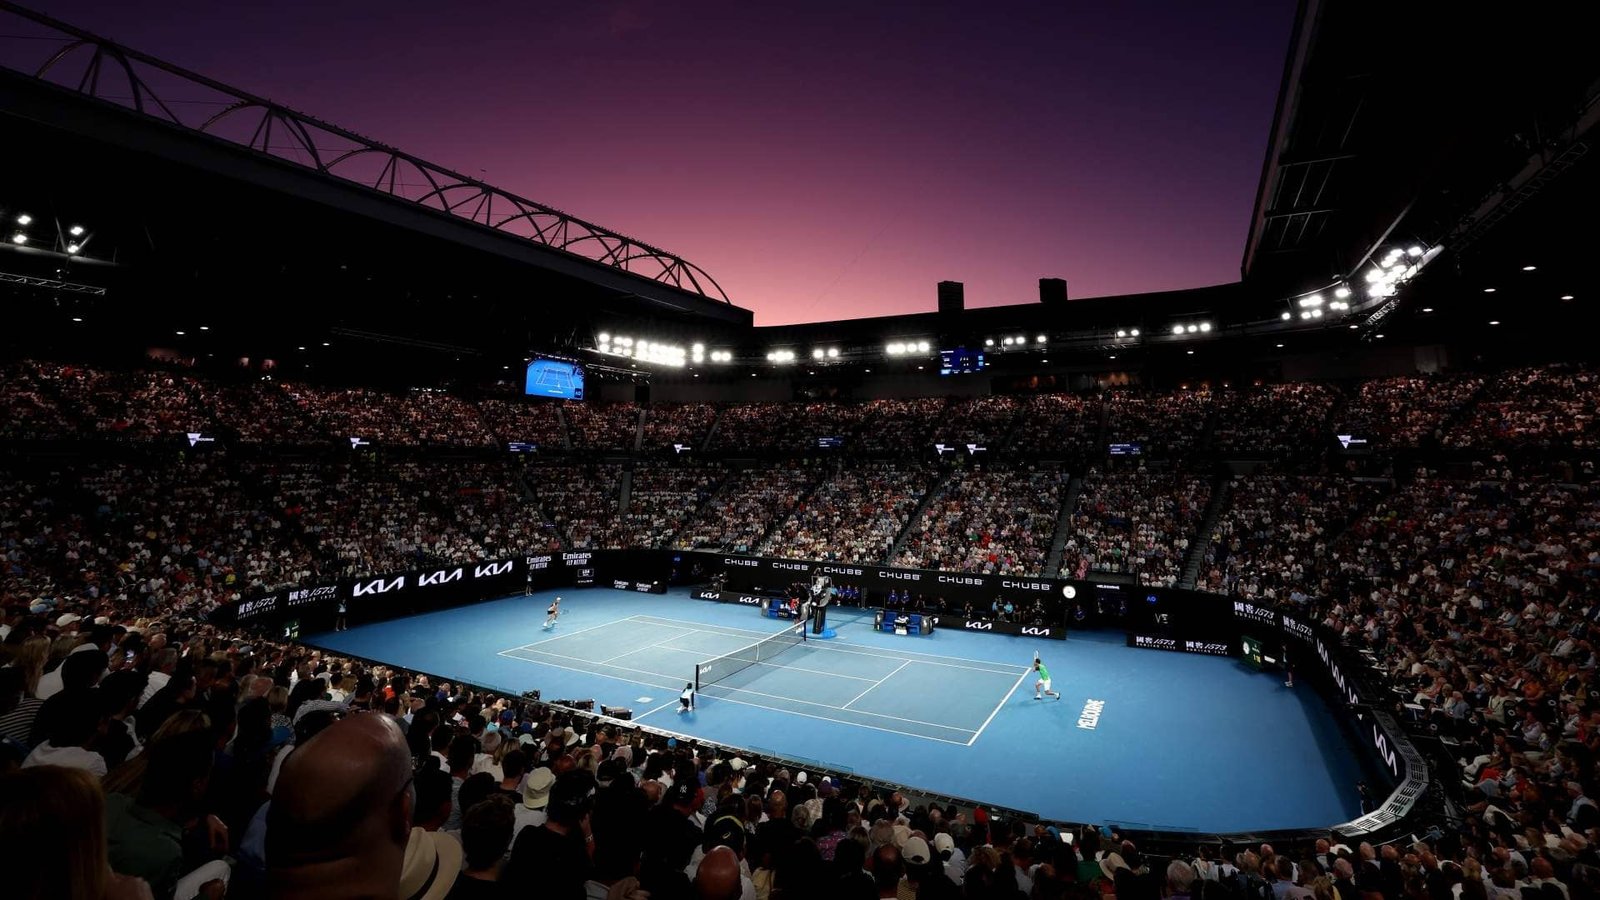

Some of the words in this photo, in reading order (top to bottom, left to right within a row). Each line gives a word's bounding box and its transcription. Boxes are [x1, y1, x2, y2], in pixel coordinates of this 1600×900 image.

[526, 555, 552, 564] Emirates
[563, 552, 592, 560] Emirates
[725, 558, 759, 567] CHUBB
[772, 562, 809, 571] CHUBB
[475, 560, 513, 578] KIA
[824, 566, 863, 576] CHUBB
[418, 568, 462, 587] KIA
[879, 571, 921, 581] CHUBB
[938, 575, 983, 586] CHUBB
[353, 576, 404, 597] KIA
[1002, 580, 1051, 591] CHUBB
[739, 596, 760, 604] KIA
[965, 621, 992, 630] KIA
[1021, 626, 1050, 636] KIA
